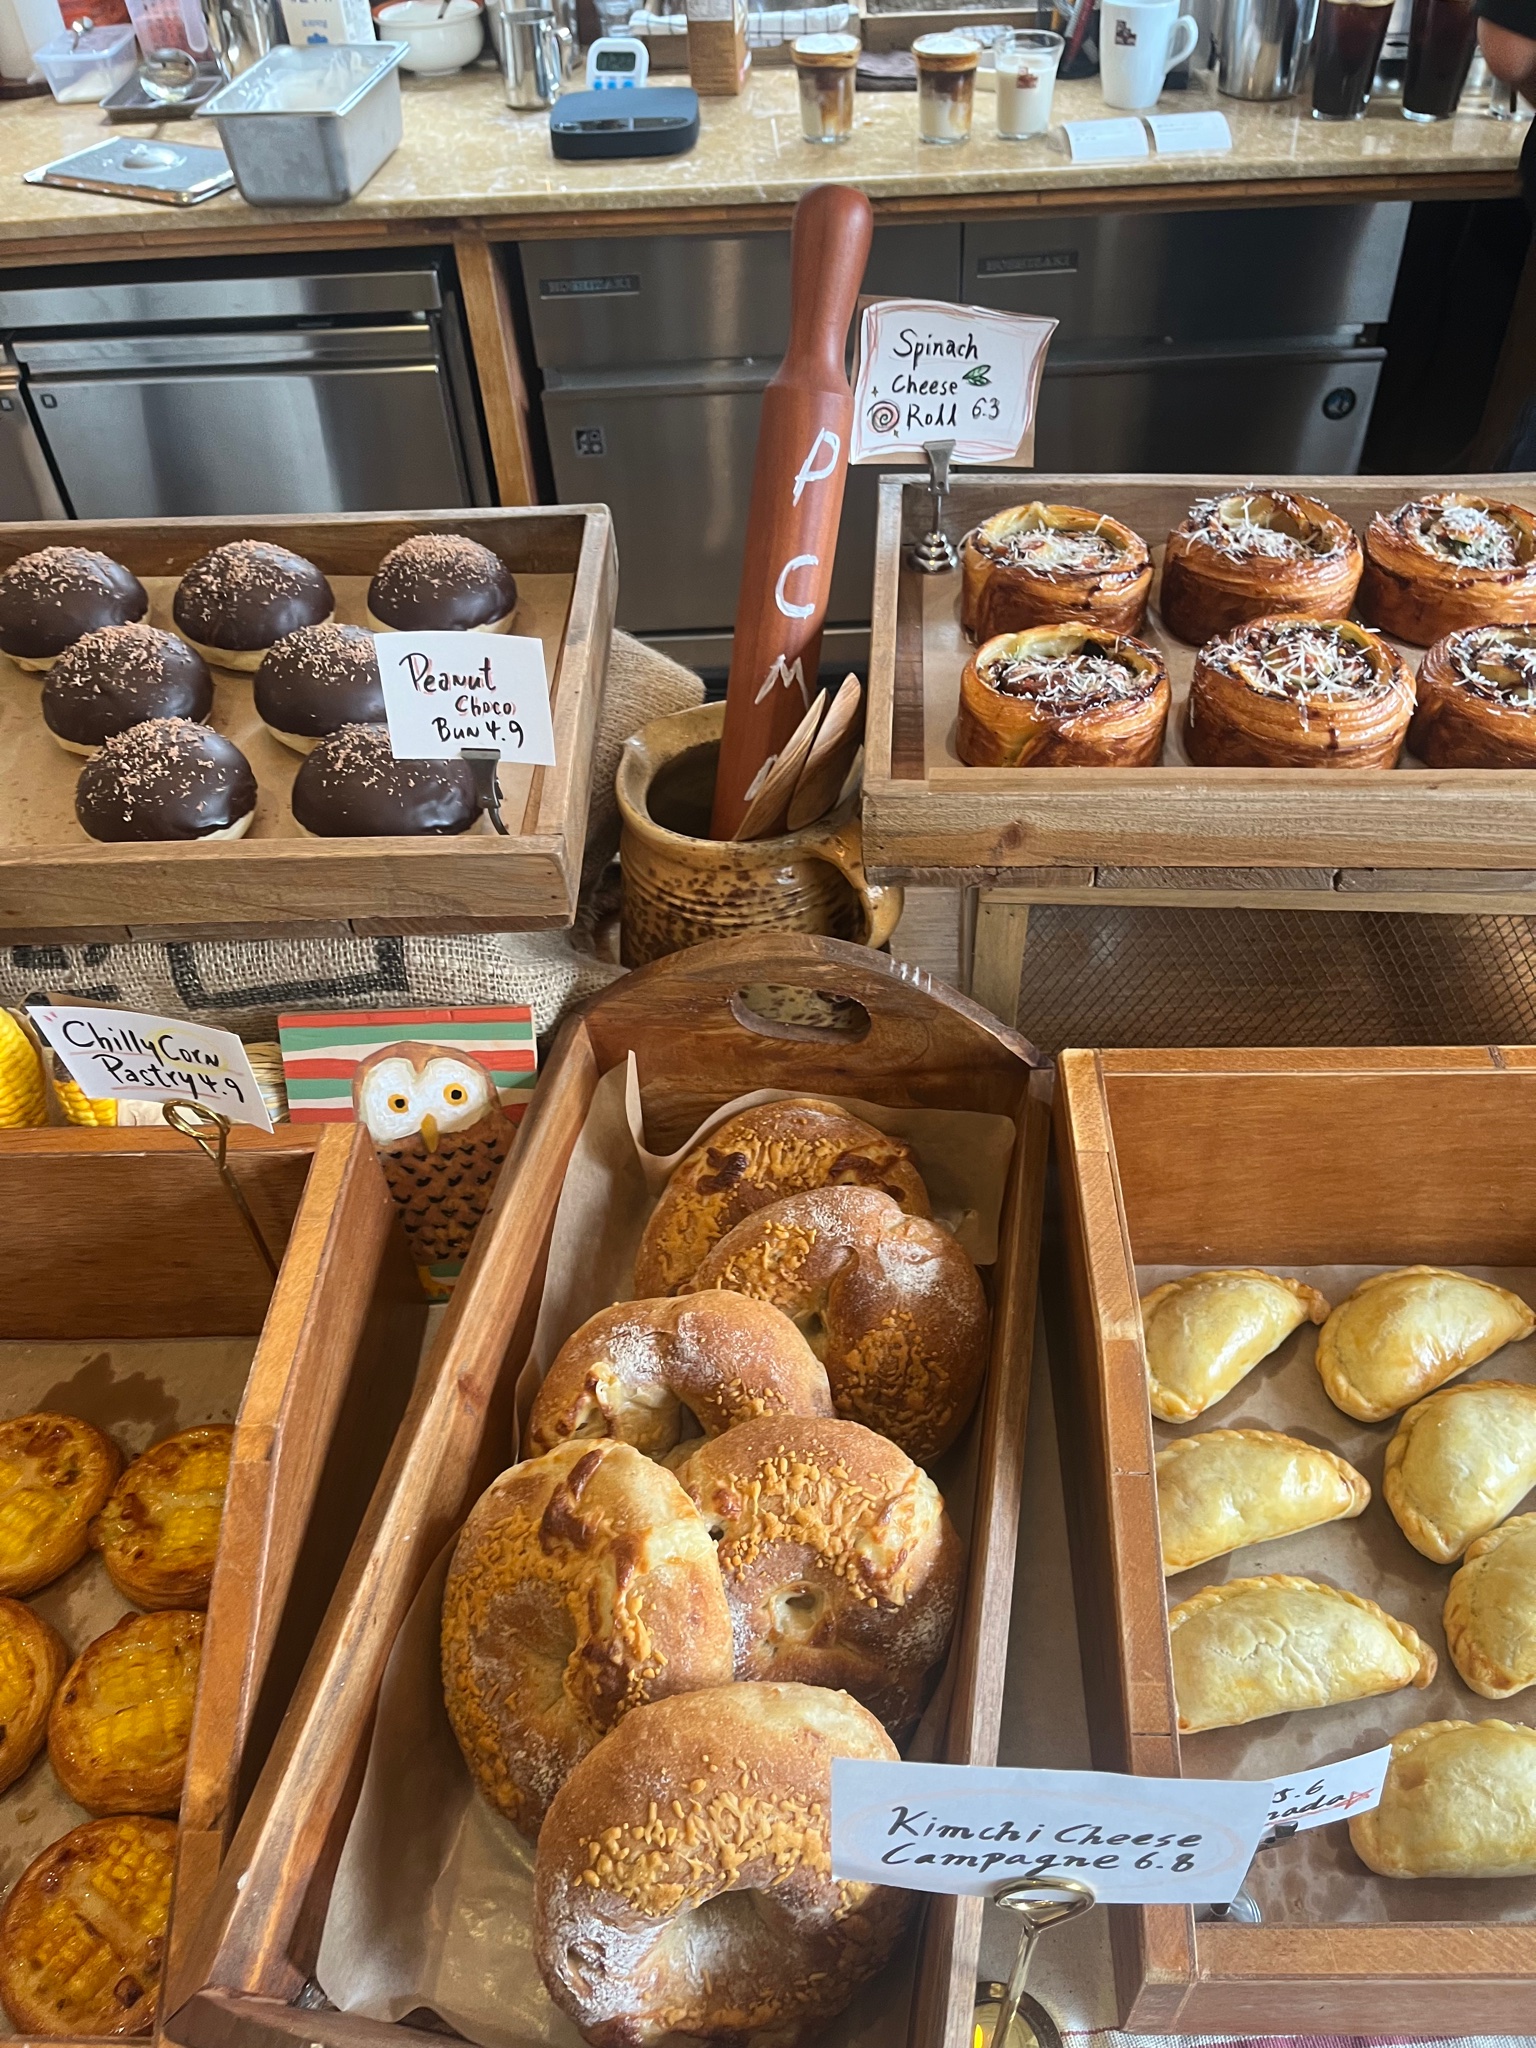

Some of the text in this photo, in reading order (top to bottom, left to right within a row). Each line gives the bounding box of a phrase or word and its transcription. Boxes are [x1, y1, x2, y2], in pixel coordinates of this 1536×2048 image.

[893, 328, 978, 370] Spinach
[891, 374, 958, 395] Cheese
[906, 402, 957, 431] Roll
[399, 652, 497, 693] Peanut
[455, 694, 514, 717] Choco
[485, 720, 524, 749] 4.9
[1266, 1794, 1346, 1820] nada
[887, 1806, 1203, 1848] Kimchi Cheese
[881, 1842, 1195, 1877] Campagne 6.8
